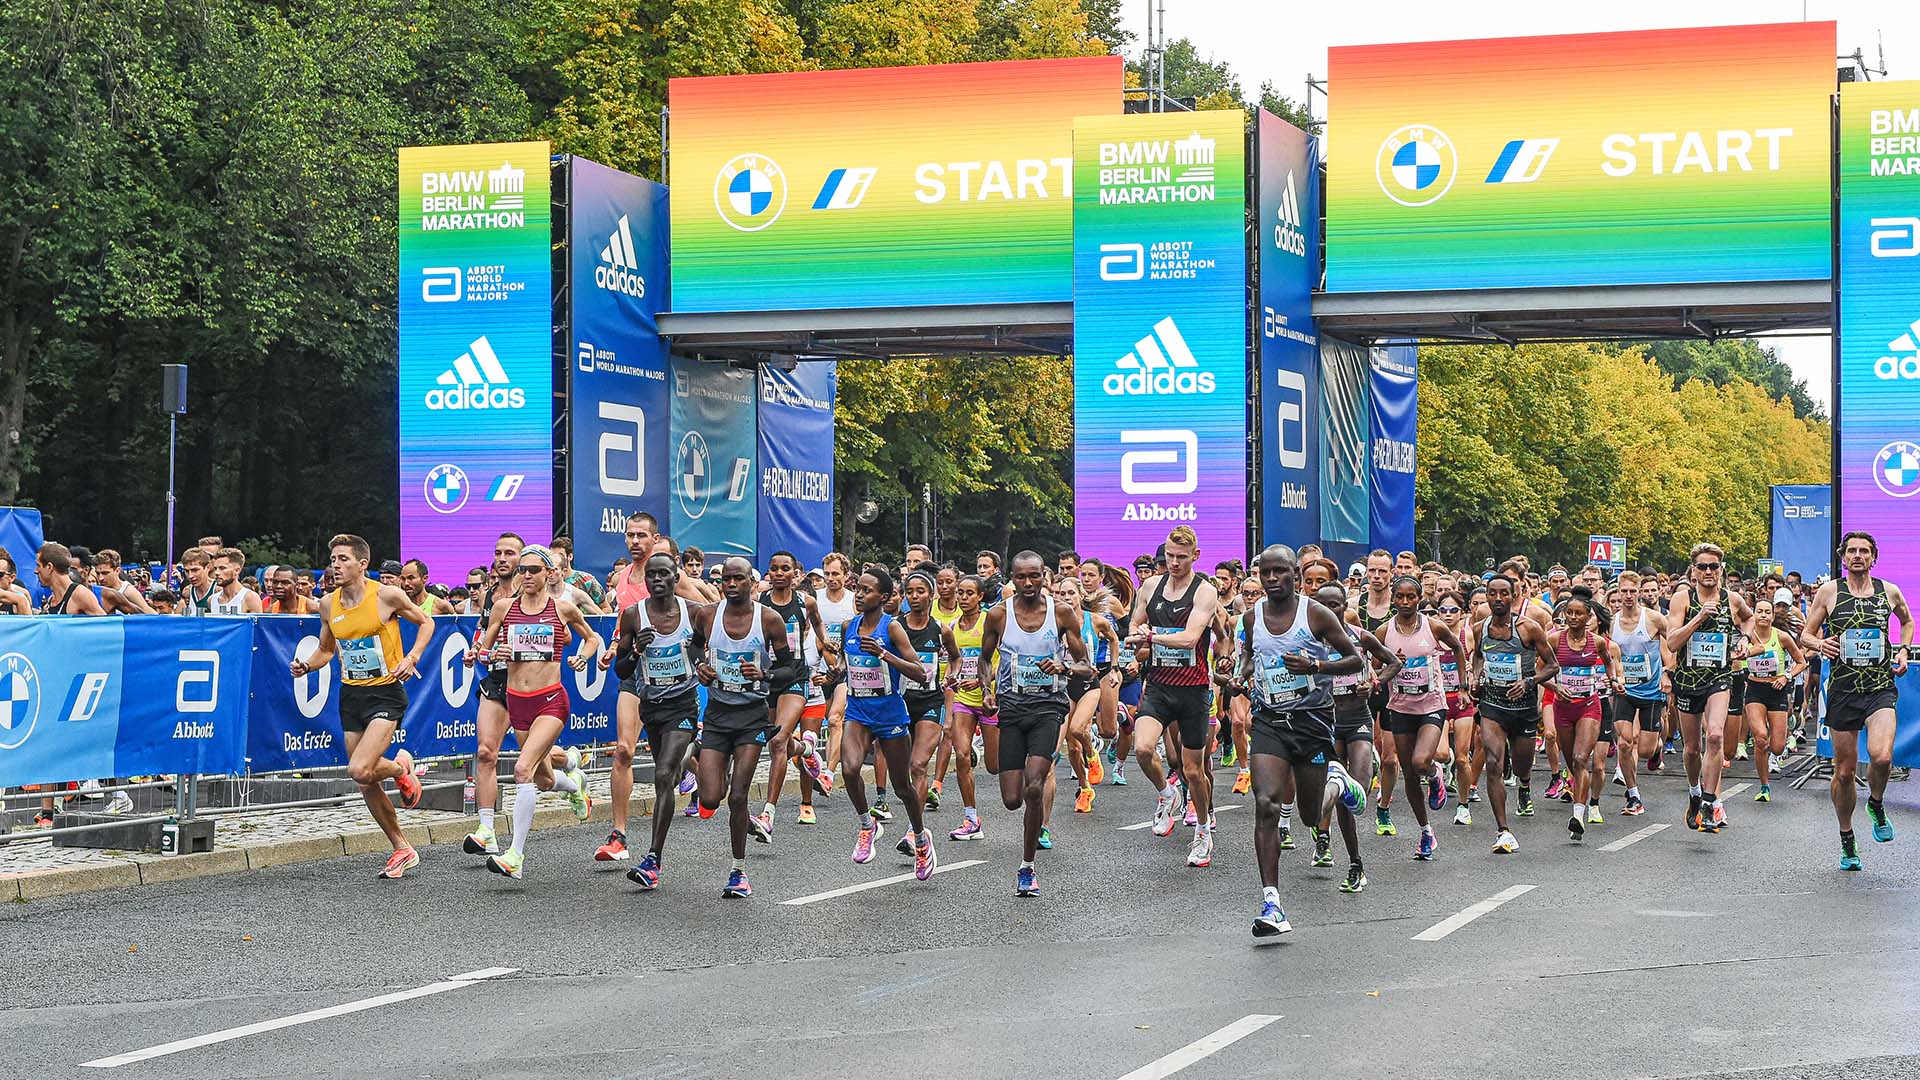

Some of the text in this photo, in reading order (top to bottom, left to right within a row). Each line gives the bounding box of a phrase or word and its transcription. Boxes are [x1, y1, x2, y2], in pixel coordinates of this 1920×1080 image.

[1871, 109, 1920, 135] BM
[1100, 141, 1169, 166] BMW
[1600, 127, 1793, 177] START
[1871, 136, 1920, 156] BER
[1871, 158, 1920, 176] MAR
[422, 171, 484, 194] BMW
[1100, 168, 1170, 185] BERLIN
[1100, 184, 1215, 205] MARATHON
[422, 195, 485, 213] BERLIN
[422, 212, 524, 231] MARATHON
[1150, 241, 1193, 251] ABBOTT
[1274, 223, 1305, 257] adidas
[1150, 250, 1190, 260] WORLD
[467, 265, 505, 275] ABBOTT
[1150, 260, 1215, 270] MARATHON
[467, 274, 502, 283] WORLD
[595, 262, 645, 298] adidas
[1150, 269, 1197, 280] MAJORS
[467, 282, 525, 292] MARATHON
[467, 292, 508, 301] MAJORS
[596, 350, 615, 361] ABBOTT
[596, 361, 665, 380] WORLD MARATHON MAJORS
[1874, 350, 1920, 380] ad
[1103, 367, 1216, 396] adidas
[424, 383, 526, 410] adidas
[763, 468, 830, 501] #BERLINLEGEND
[1280, 482, 1307, 510] Abbott
[600, 507, 637, 533] Abb
[1121, 503, 1198, 521] Abbott
[1592, 543, 1607, 560] A
[519, 635, 548, 645] D'AMATO
[1855, 642, 1871, 651] 142
[350, 655, 367, 665] SILAS
[649, 660, 682, 671] CHERUIYOT
[722, 666, 740, 677] KIPRO
[436, 720, 476, 739] Das Erste
[570, 712, 608, 729] Das Erste
[173, 721, 214, 739] Abbott
[390, 728, 407, 744] ste
[284, 730, 333, 752] Das Erste
